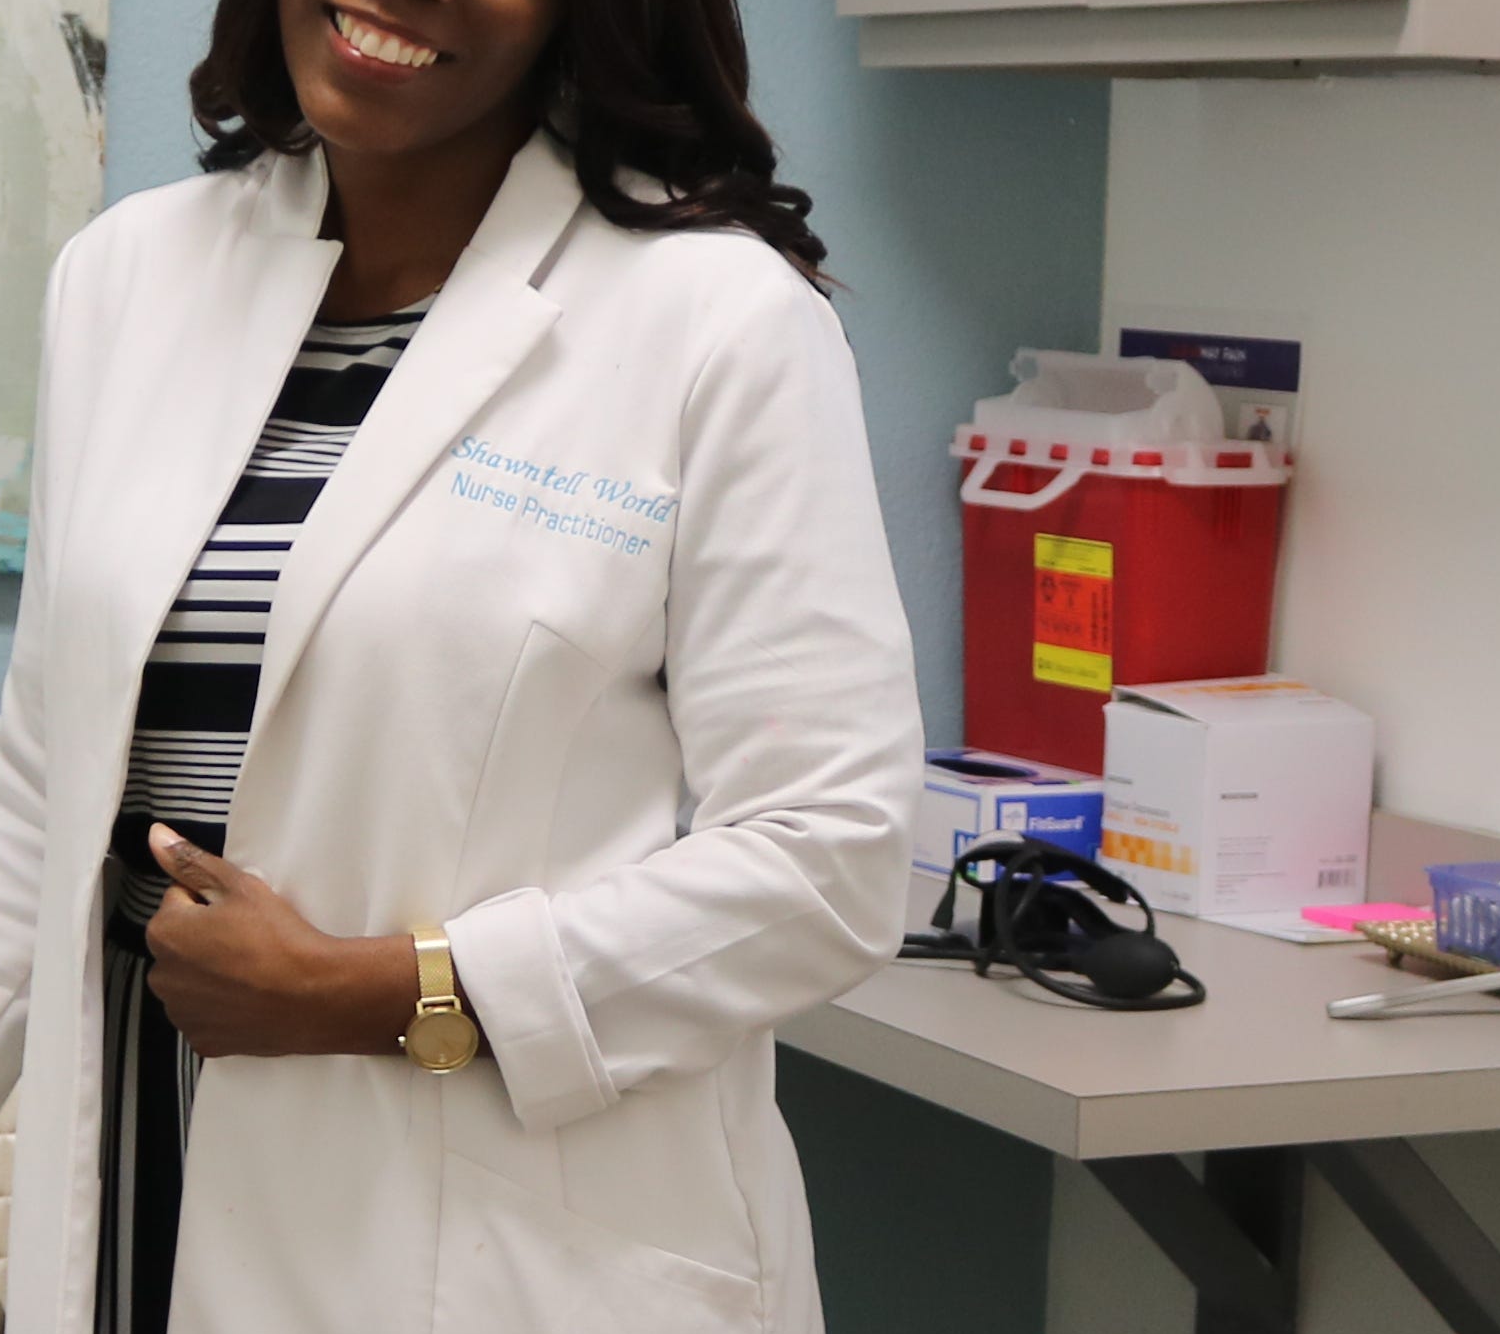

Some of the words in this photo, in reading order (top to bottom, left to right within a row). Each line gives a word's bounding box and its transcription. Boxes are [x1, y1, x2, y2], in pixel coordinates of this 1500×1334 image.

[451, 435, 589, 496] Shawntell
[593, 478, 680, 523] World
[451, 471, 518, 512] Nurse
[522, 496, 651, 556] Practitioner
